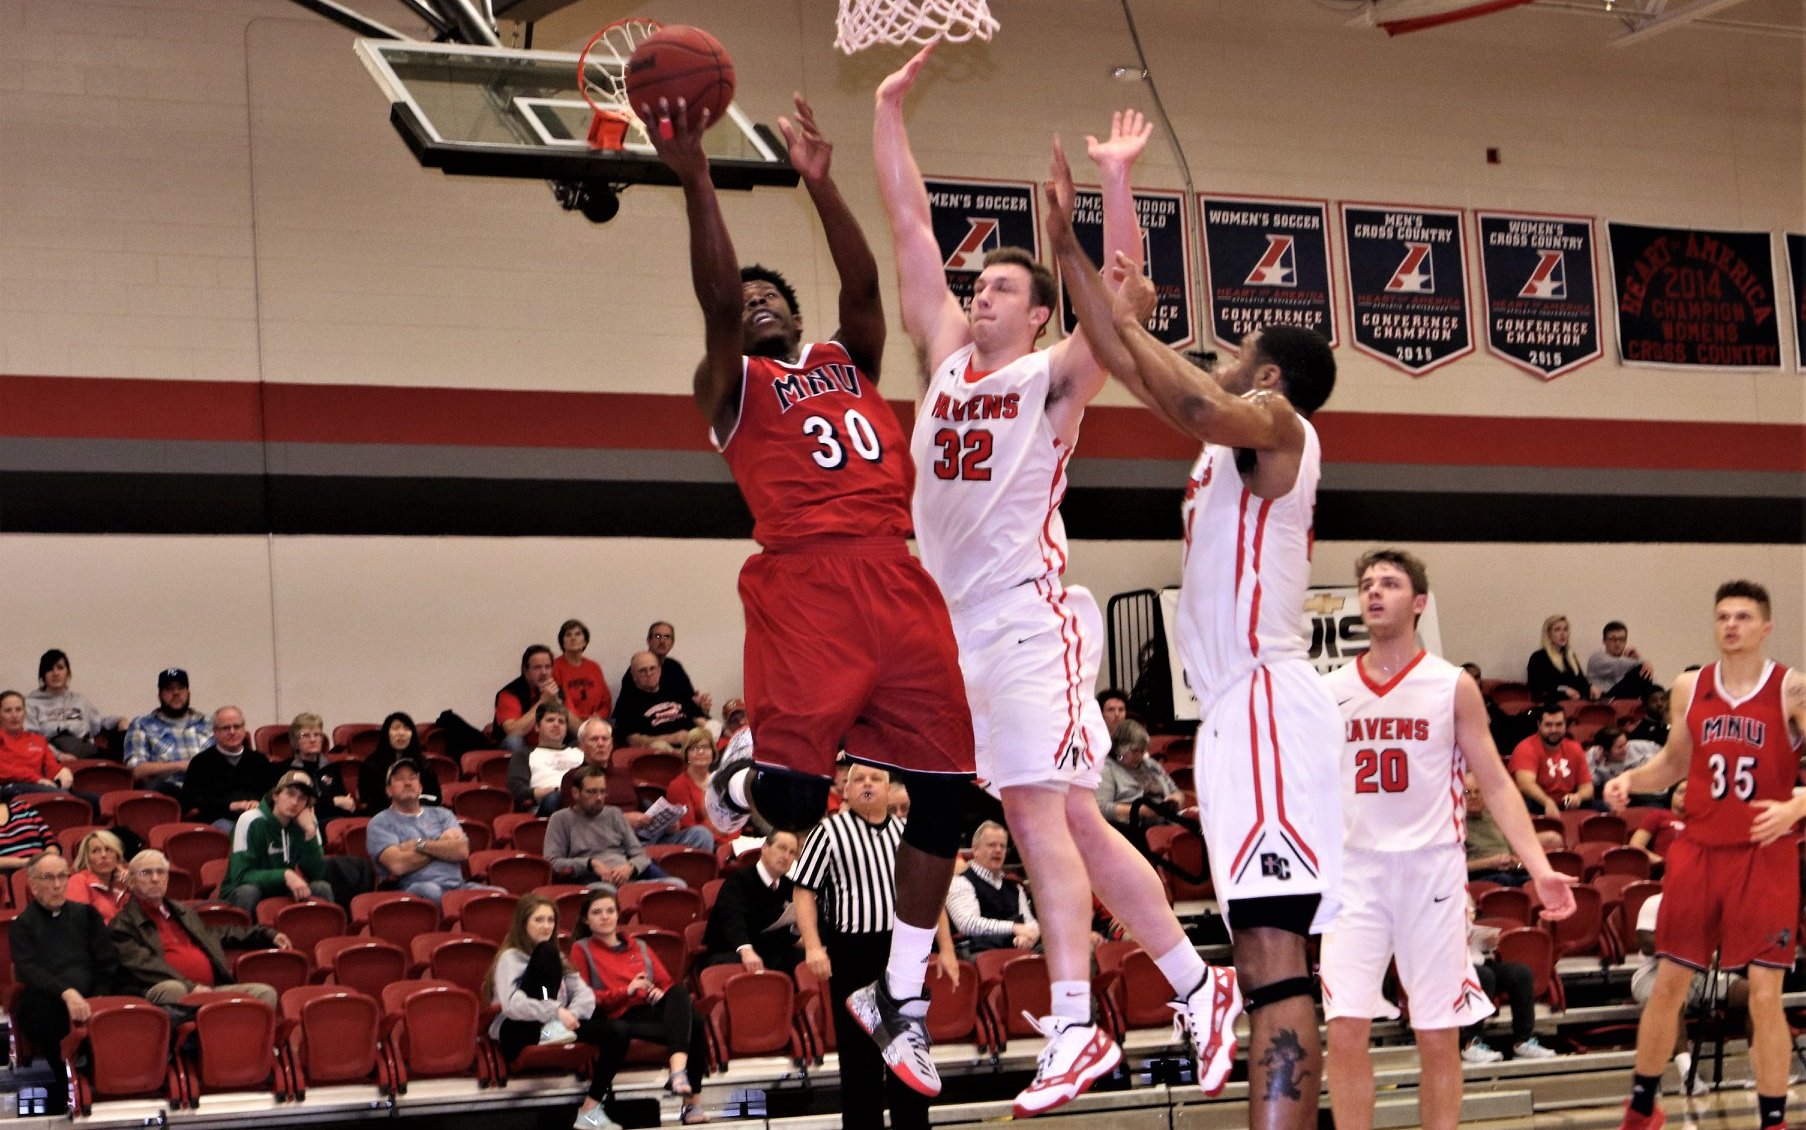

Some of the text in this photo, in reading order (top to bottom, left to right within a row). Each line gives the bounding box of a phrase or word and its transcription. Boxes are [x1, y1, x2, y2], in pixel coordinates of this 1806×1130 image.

[976, 194, 1028, 212] SOCCER
[1134, 199, 1176, 215] NDOOR
[1072, 209, 1103, 224] TRAC
[1209, 210, 1320, 230] WOMEN'S SOCCER
[1384, 213, 1424, 228] MEN'S
[1354, 223, 1453, 243] CROSS COUNTRY
[1508, 221, 1564, 236] WOMEN'S
[1490, 231, 1584, 251] CROSS COUNTRY
[1663, 266, 1722, 300] 2014
[1686, 231, 1773, 327] AMERICA
[1221, 307, 1323, 324] CONFERENCE
[1651, 299, 1746, 321] CHAMPION
[1362, 313, 1459, 329] CONFERENCE
[1496, 318, 1588, 335] CONFERENCE
[1373, 326, 1452, 341] CHAMPION
[1506, 330, 1581, 346] CHAMPION
[1662, 320, 1738, 343] WOMENS
[1396, 346, 1433, 361] 2015
[1528, 350, 1562, 366] 2015
[1628, 339, 1777, 365] CROSS COUNTRY
[772, 363, 862, 414] MNU
[803, 409, 883, 471] 30
[933, 428, 993, 482] 32
[1346, 717, 1429, 742] AVENS
[1701, 714, 1766, 749] MNU
[1355, 748, 1409, 794] 20
[1708, 753, 1757, 803] 35
